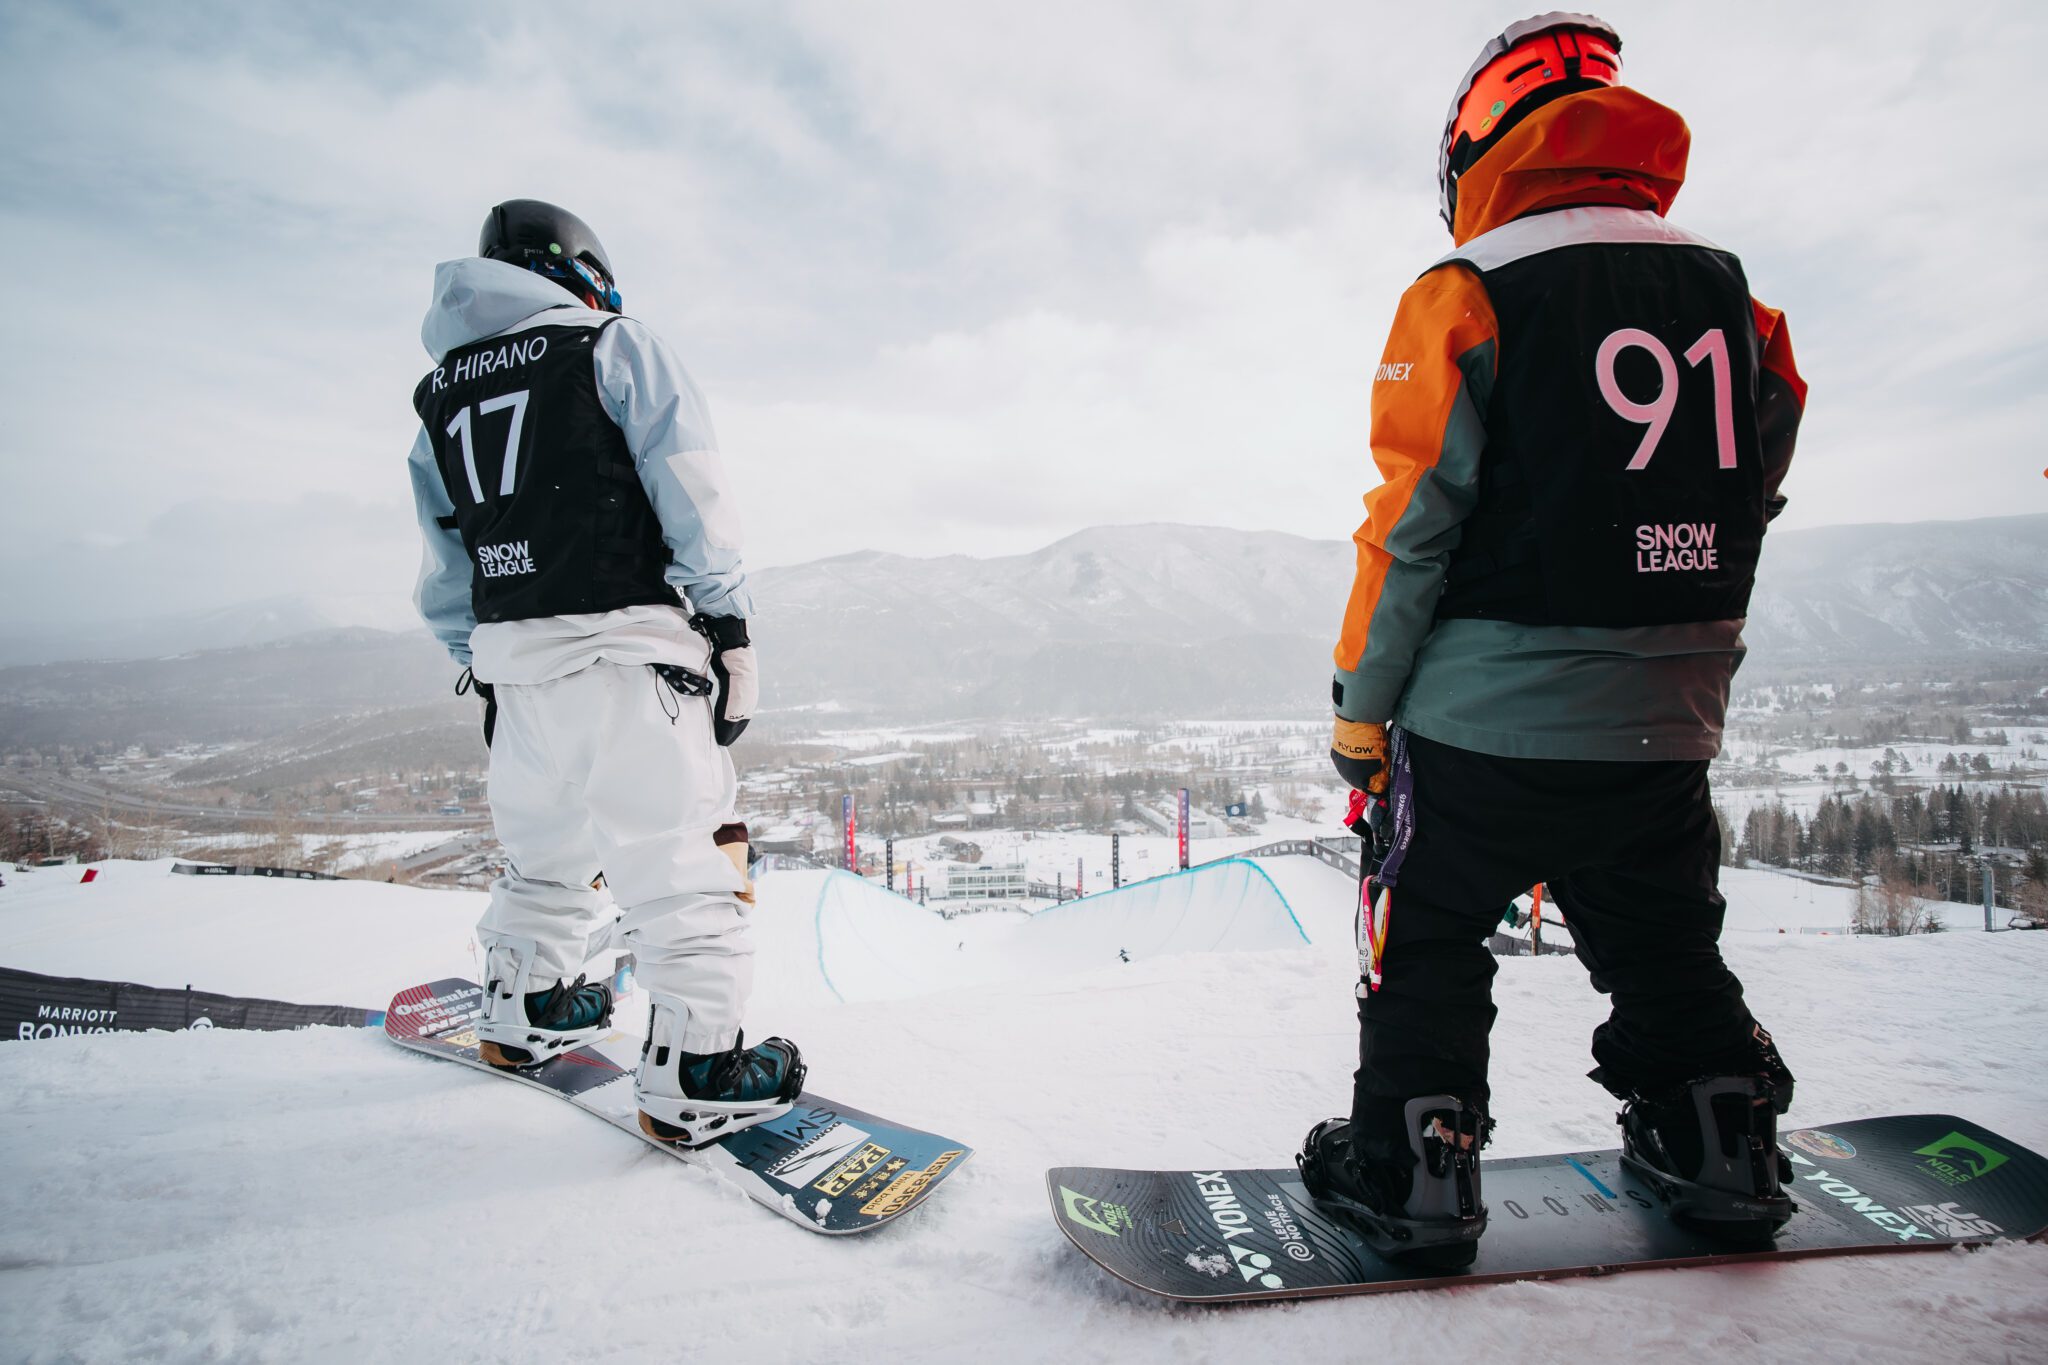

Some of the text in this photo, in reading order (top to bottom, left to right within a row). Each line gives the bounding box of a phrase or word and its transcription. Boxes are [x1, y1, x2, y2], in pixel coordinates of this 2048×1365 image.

[431, 336, 548, 394] R. HIRANO
[1376, 363, 1414, 381] ONEX
[1595, 328, 1738, 471] 91
[446, 389, 530, 504] 17
[1636, 523, 1717, 550] SNOW
[478, 541, 530, 564] SNOW
[1637, 549, 1719, 573] LEAGUE
[483, 558, 537, 578] LEAGUE
[1338, 741, 1375, 754] FLYLOW
[38, 1005, 118, 1023] MARRIOTT
[395, 987, 484, 1016] Onitsuka
[421, 1001, 476, 1020] Tiger
[18, 1021, 118, 1041] BON
[735, 1106, 838, 1171] SMITH
[765, 1120, 843, 1174] DOMINATOR
[831, 1147, 886, 1193] PAP
[881, 1151, 961, 1214] Insta360
[1924, 1158, 1973, 1182] NOLS
[1100, 1201, 1120, 1228] NOLS
[1192, 1171, 1254, 1240] YONEX
[1803, 1170, 1936, 1242] YONEX
[1264, 1210, 1290, 1240] LEAVE
